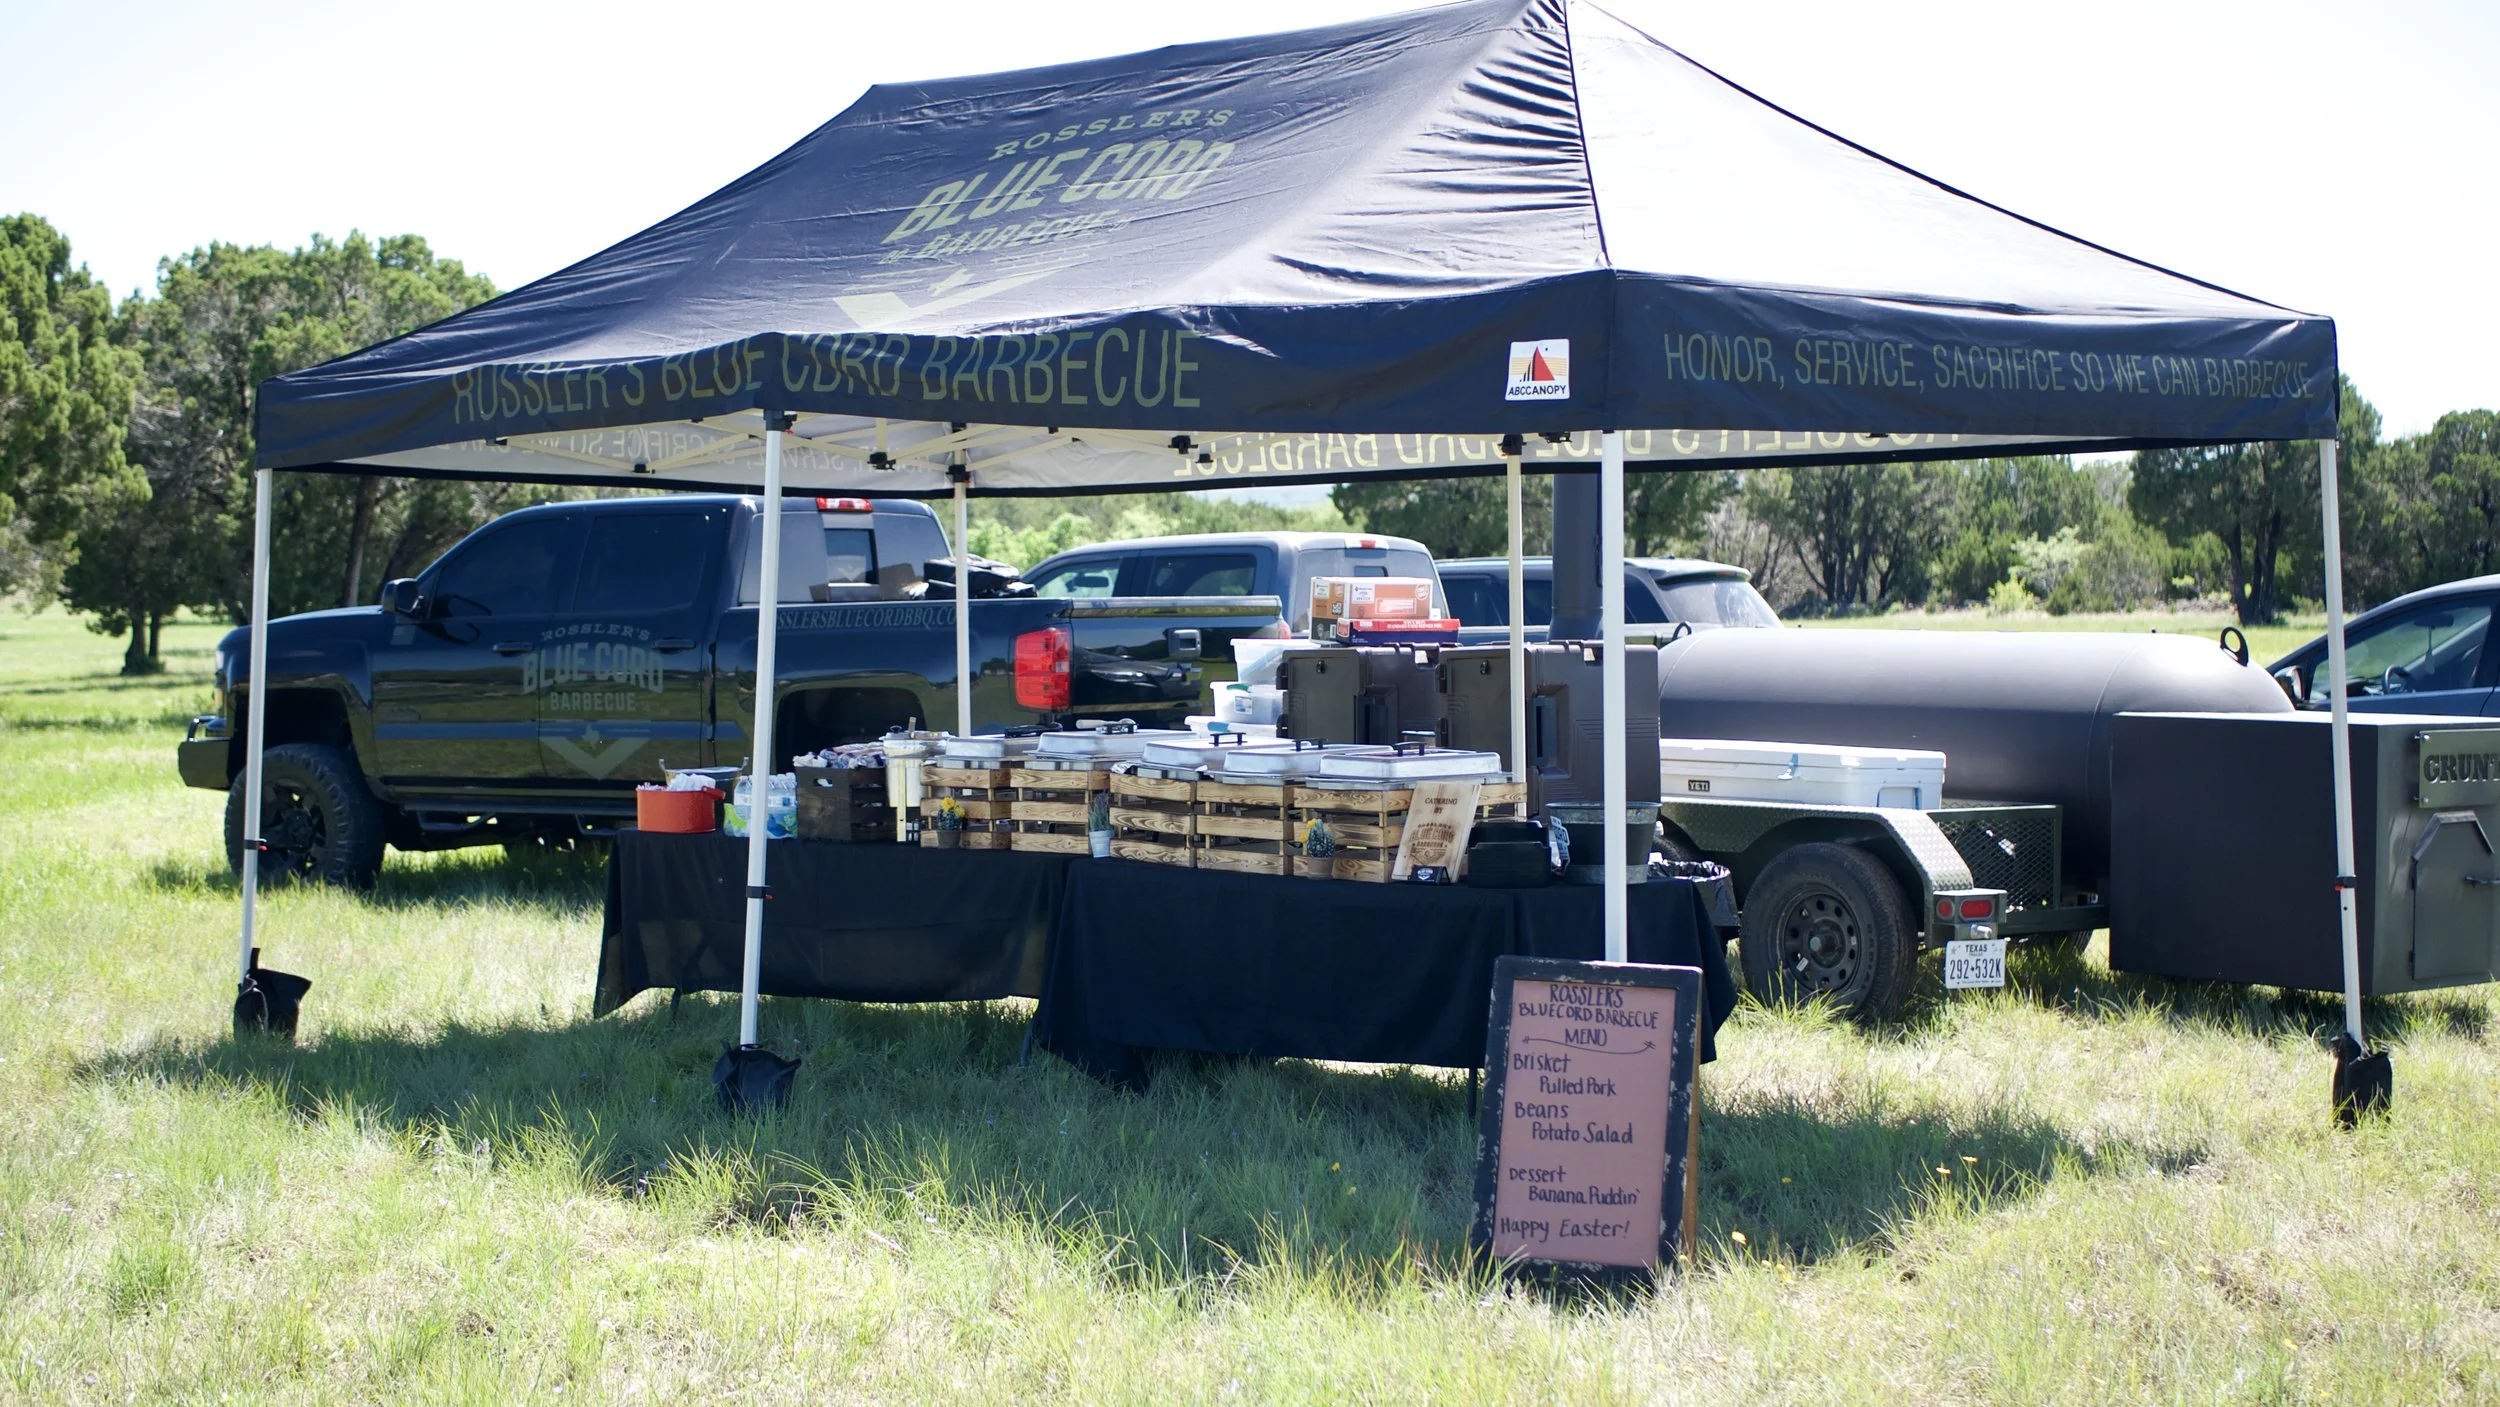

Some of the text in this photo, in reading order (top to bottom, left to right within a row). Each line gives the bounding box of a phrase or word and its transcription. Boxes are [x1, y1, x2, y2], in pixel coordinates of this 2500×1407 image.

[987, 109, 1236, 162] ROSSLER'S
[881, 140, 1236, 245] BLUE CORD
[452, 328, 1201, 424] ROSSLERS BLUE CORD BARBECUE
[1664, 333, 2314, 399] HONOR, SERVICE, SACRIFICE SO WE CAN BARBECUE
[1508, 385, 1566, 395] ABCCANOPY
[777, 606, 964, 630] SSLERSBLUECORDBBQ.CO
[540, 623, 650, 641] ROSSLER'S
[522, 642, 664, 695] BLUE CORD
[550, 692, 636, 712] BARBECUE
[1689, 781, 1710, 791] YETI
[1965, 944, 1988, 953] TEXAS
[1596, 1007, 1659, 1030] BARBECUE
[1565, 1028, 1608, 1047] MENU
[1513, 1053, 1572, 1072] Brisket
[1540, 1076, 1617, 1096] Pulled Pork
[1514, 1101, 1569, 1119] Beans
[1532, 1121, 1634, 1145] Potato Salad
[1509, 1165, 1566, 1183] Dessert
[1528, 1185, 1587, 1205] Banana
[1500, 1217, 1631, 1243] Happy Easter!
